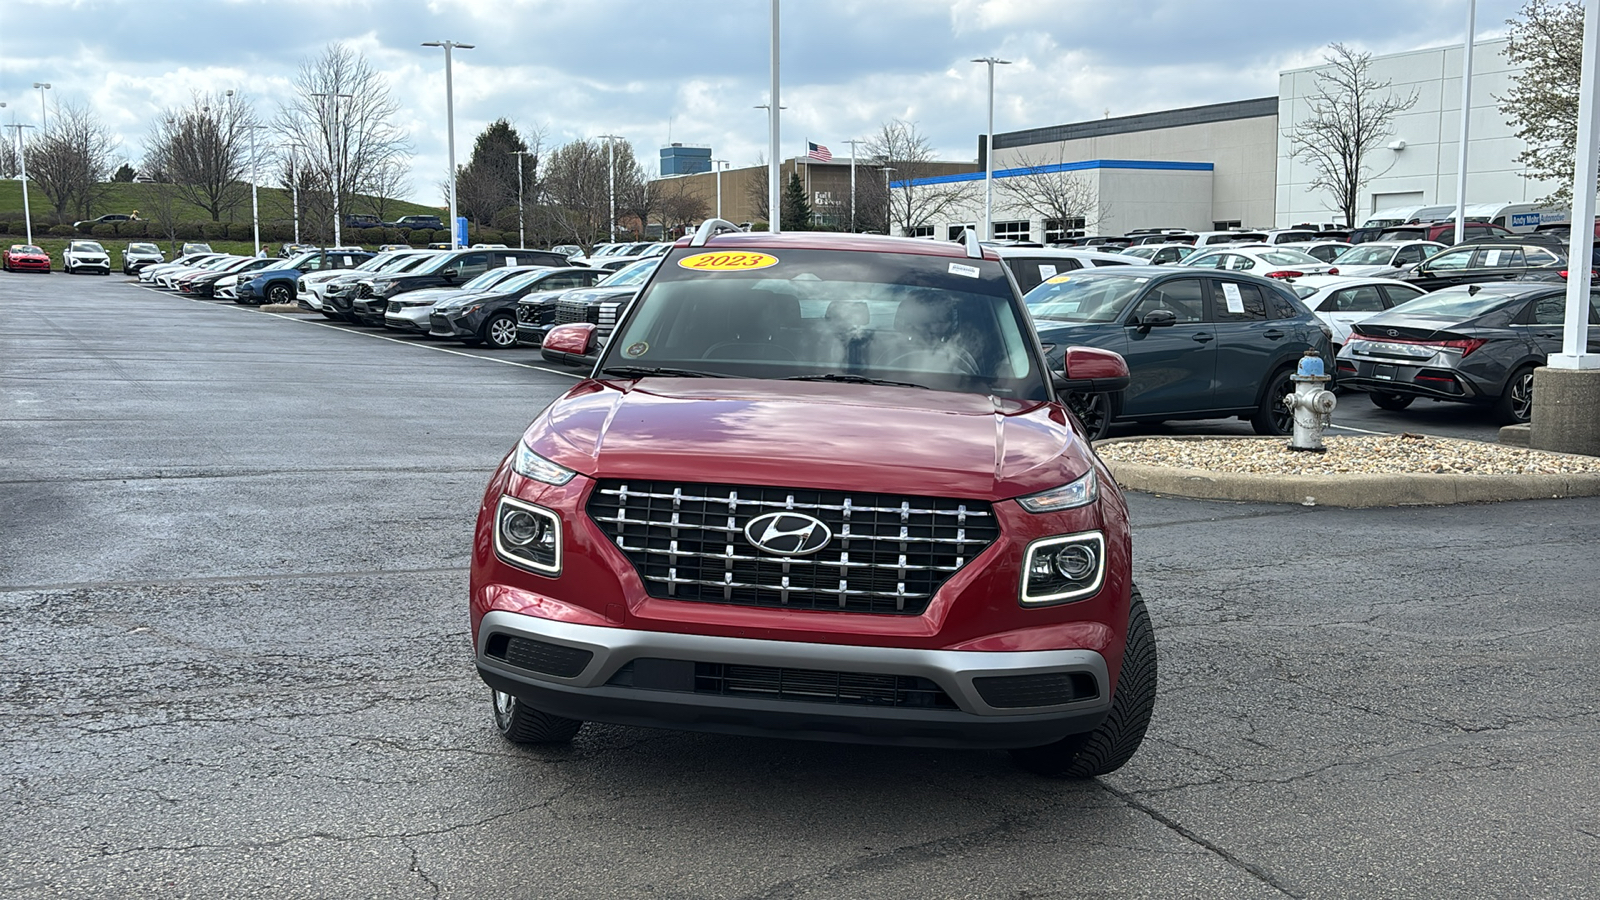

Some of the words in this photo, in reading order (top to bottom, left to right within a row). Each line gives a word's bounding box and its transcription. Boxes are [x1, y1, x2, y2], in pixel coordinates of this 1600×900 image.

[1513, 216, 1526, 226] Andy
[1526, 215, 1539, 224] Mohr
[1541, 213, 1565, 222] Automotive
[693, 255, 764, 267] 2023
